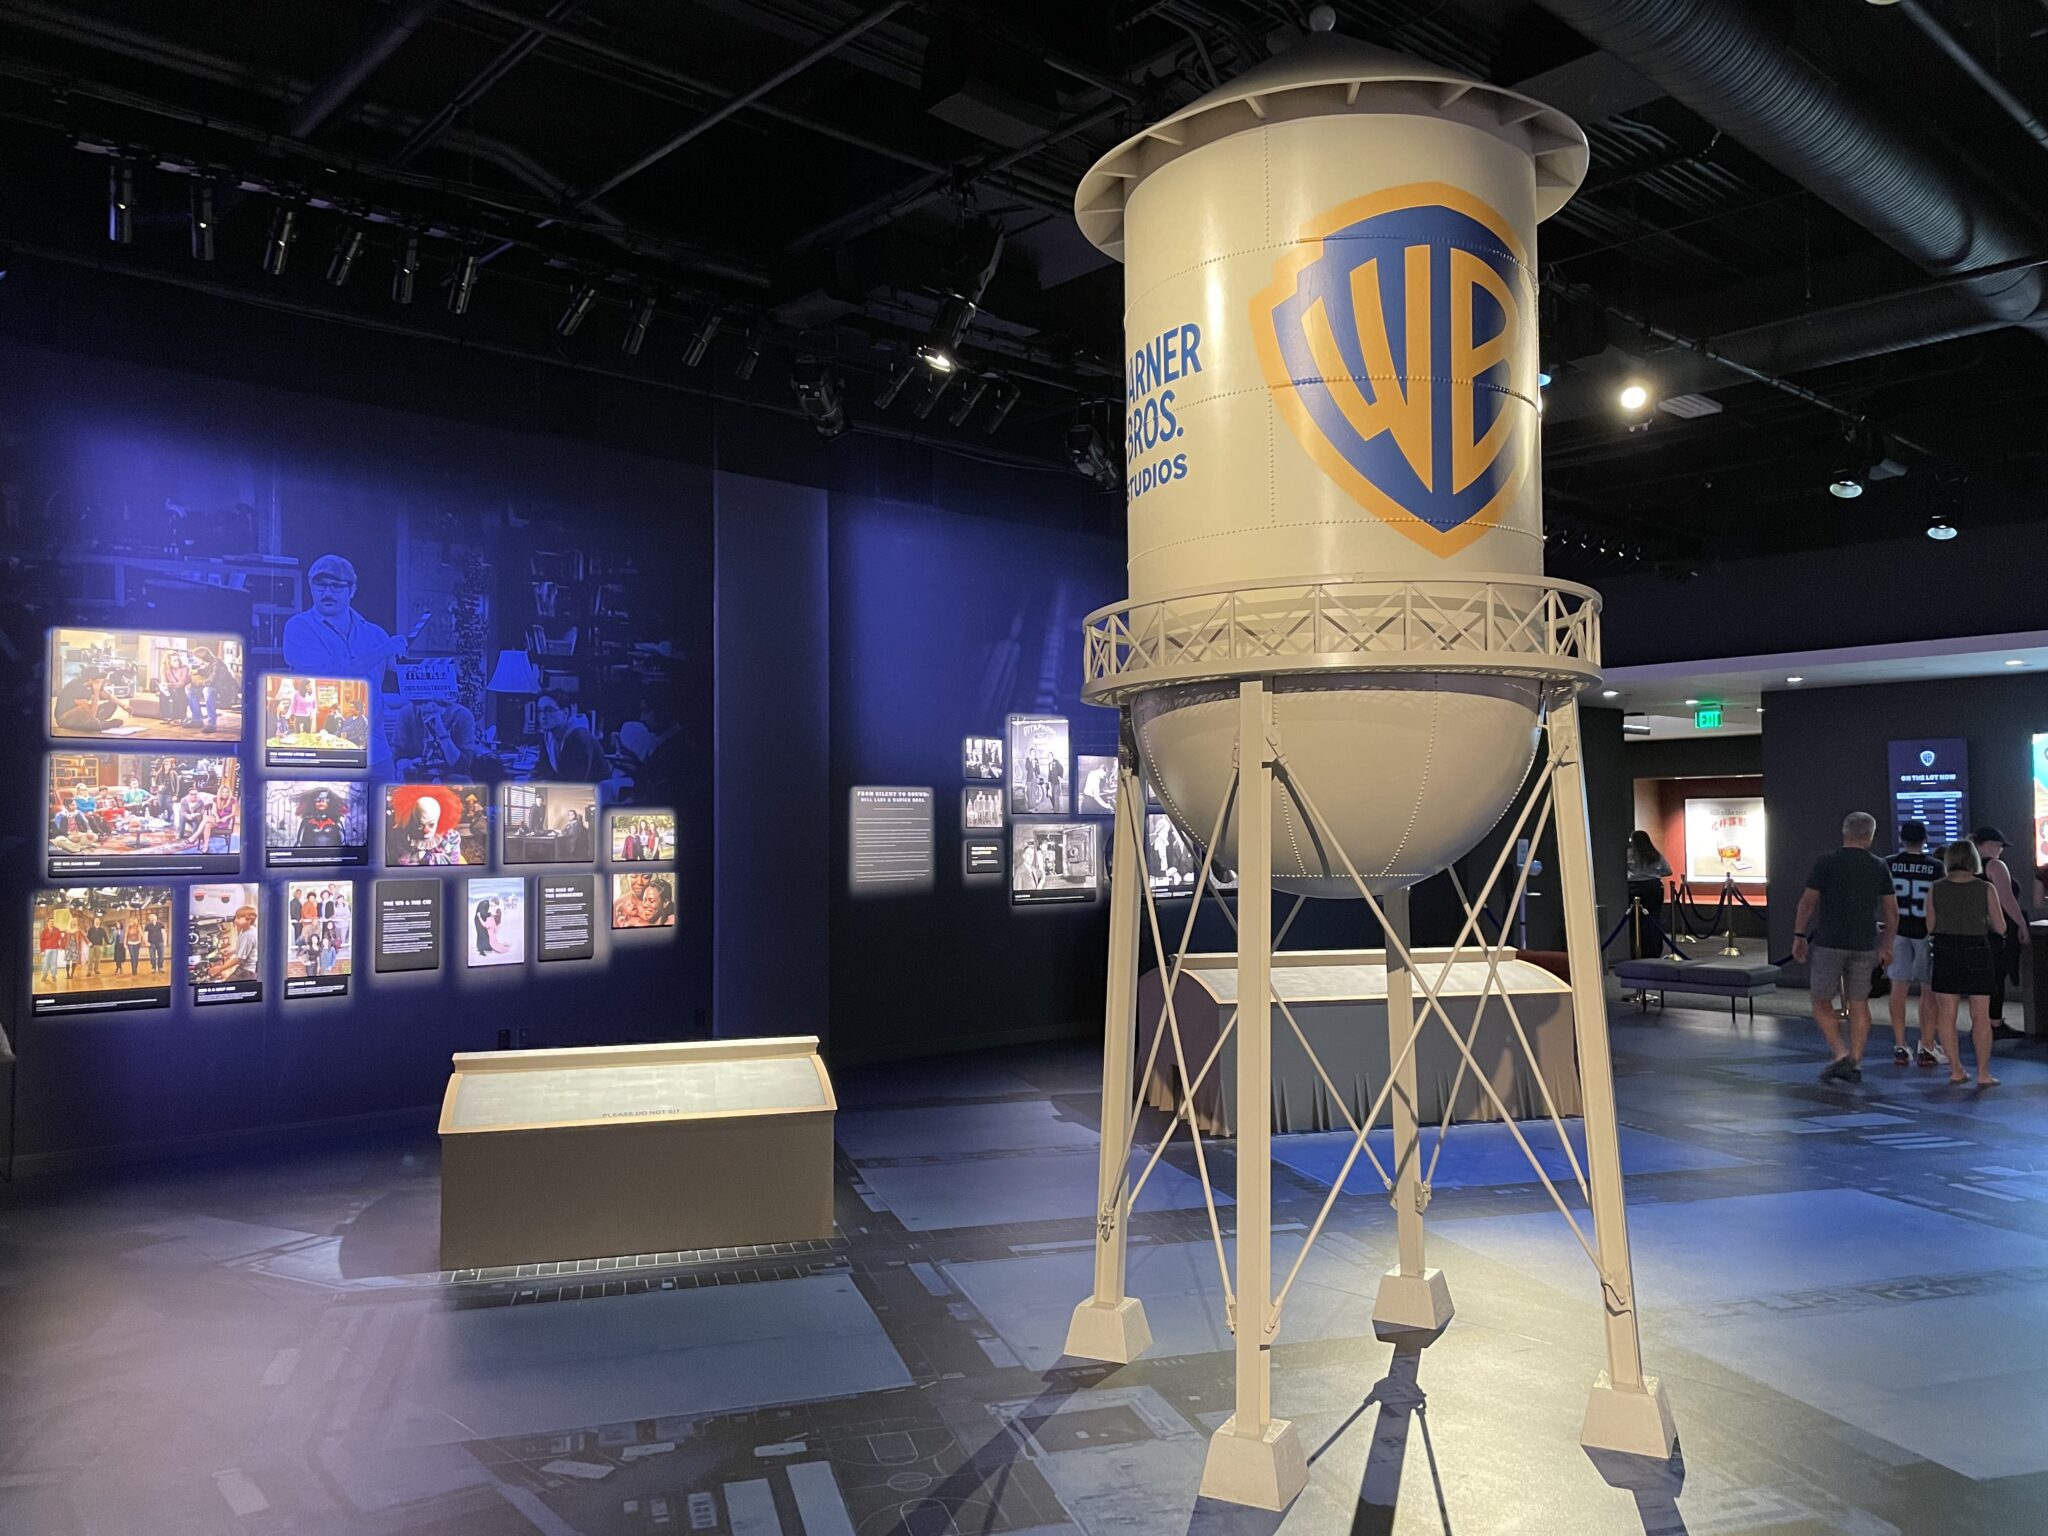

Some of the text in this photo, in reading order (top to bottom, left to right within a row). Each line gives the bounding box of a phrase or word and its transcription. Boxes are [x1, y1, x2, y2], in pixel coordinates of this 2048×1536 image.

[1126, 322, 1203, 408] ARNER
[1300, 244, 1520, 496] WB
[1699, 711, 1720, 728] EXIT
[1892, 863, 1934, 874] DOLBERG
[602, 1111, 634, 1119] PLEASE
